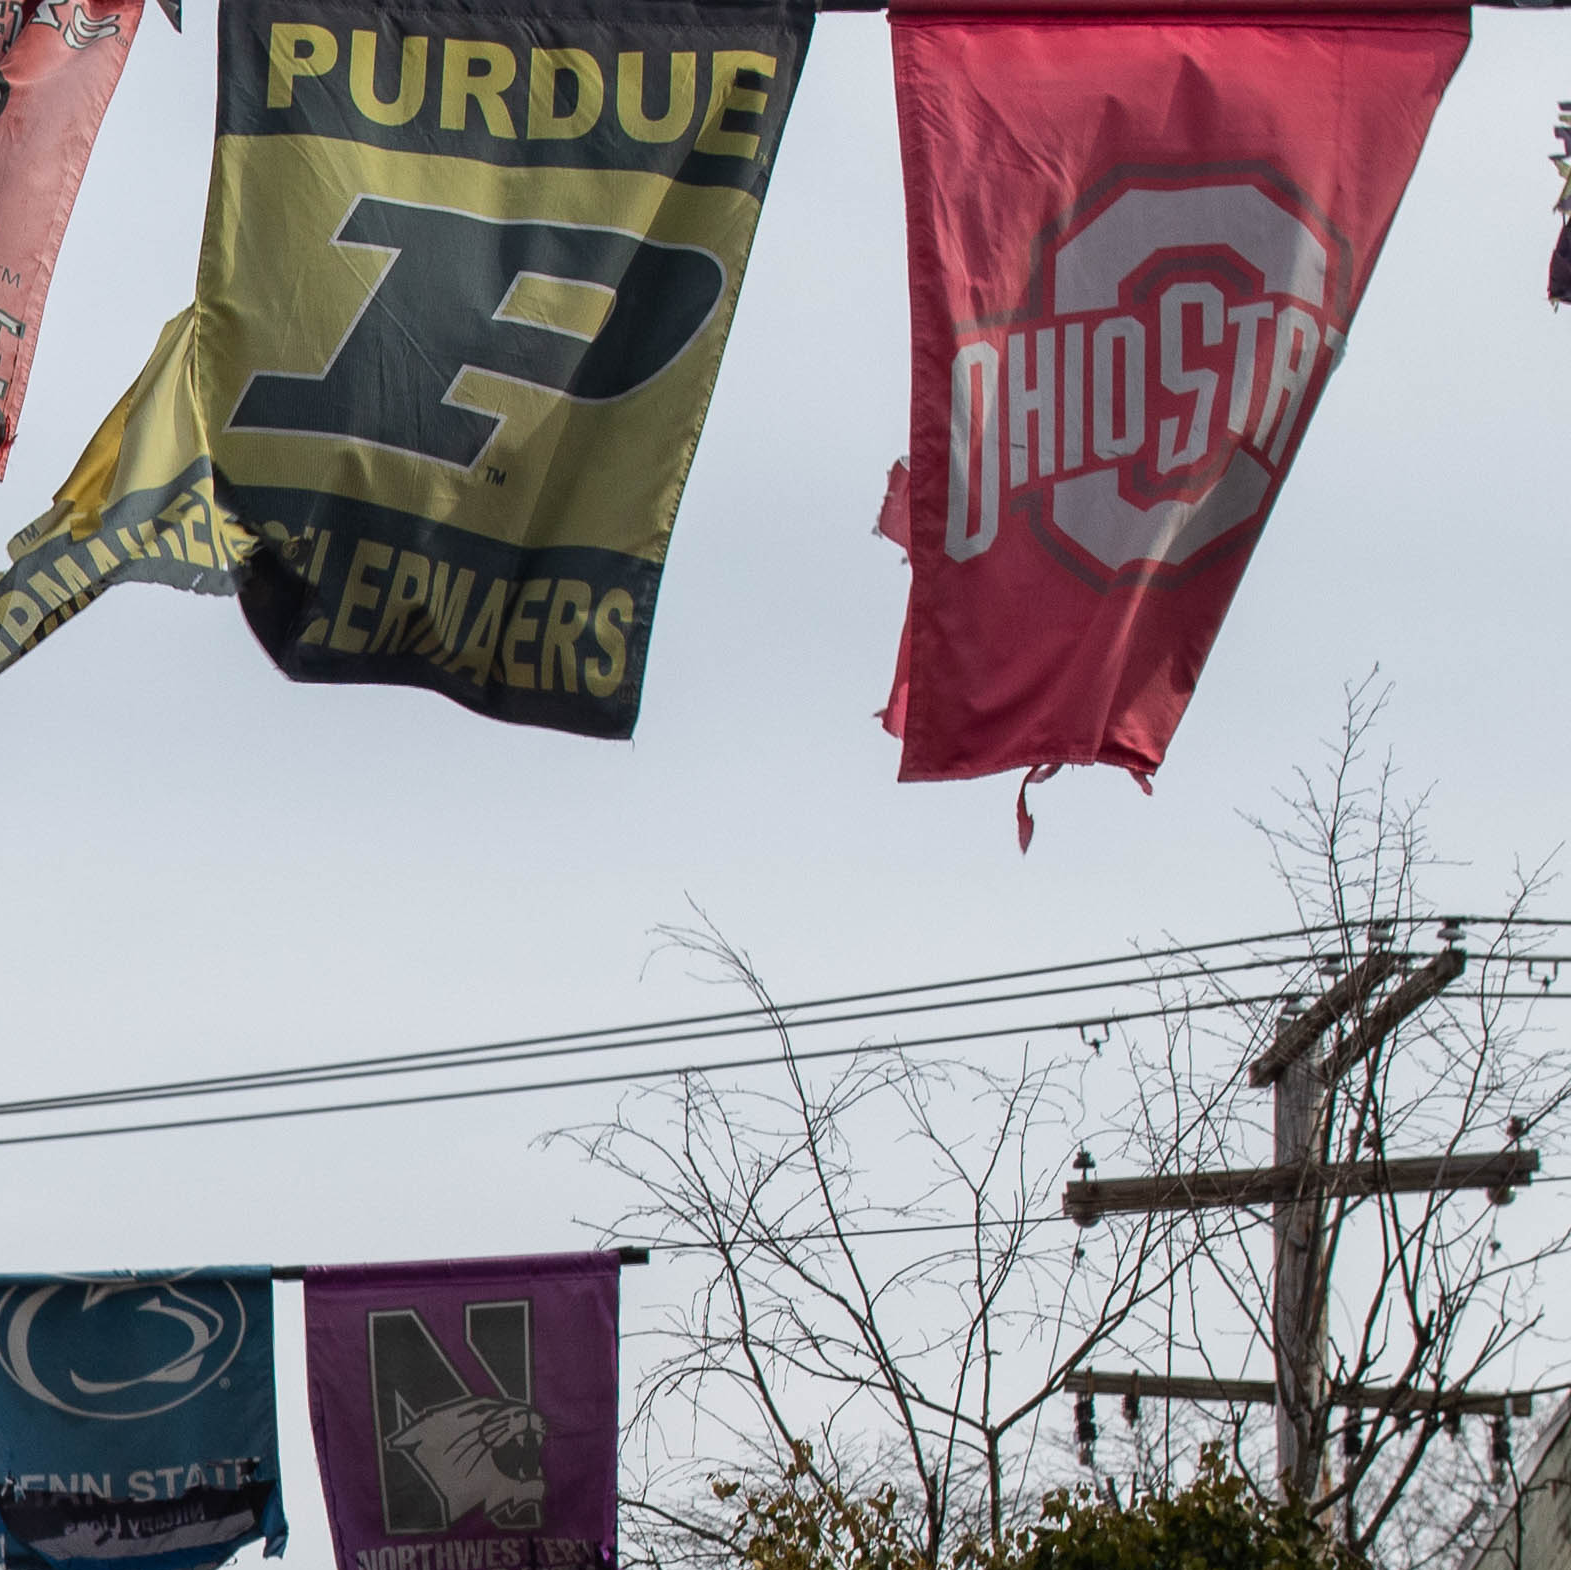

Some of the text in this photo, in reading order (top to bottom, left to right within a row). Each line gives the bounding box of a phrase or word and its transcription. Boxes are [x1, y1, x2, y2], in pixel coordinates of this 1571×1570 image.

[266, 22, 779, 160] PURDUE
[224, 193, 727, 475] P
[944, 316, 1147, 563] OHIO
